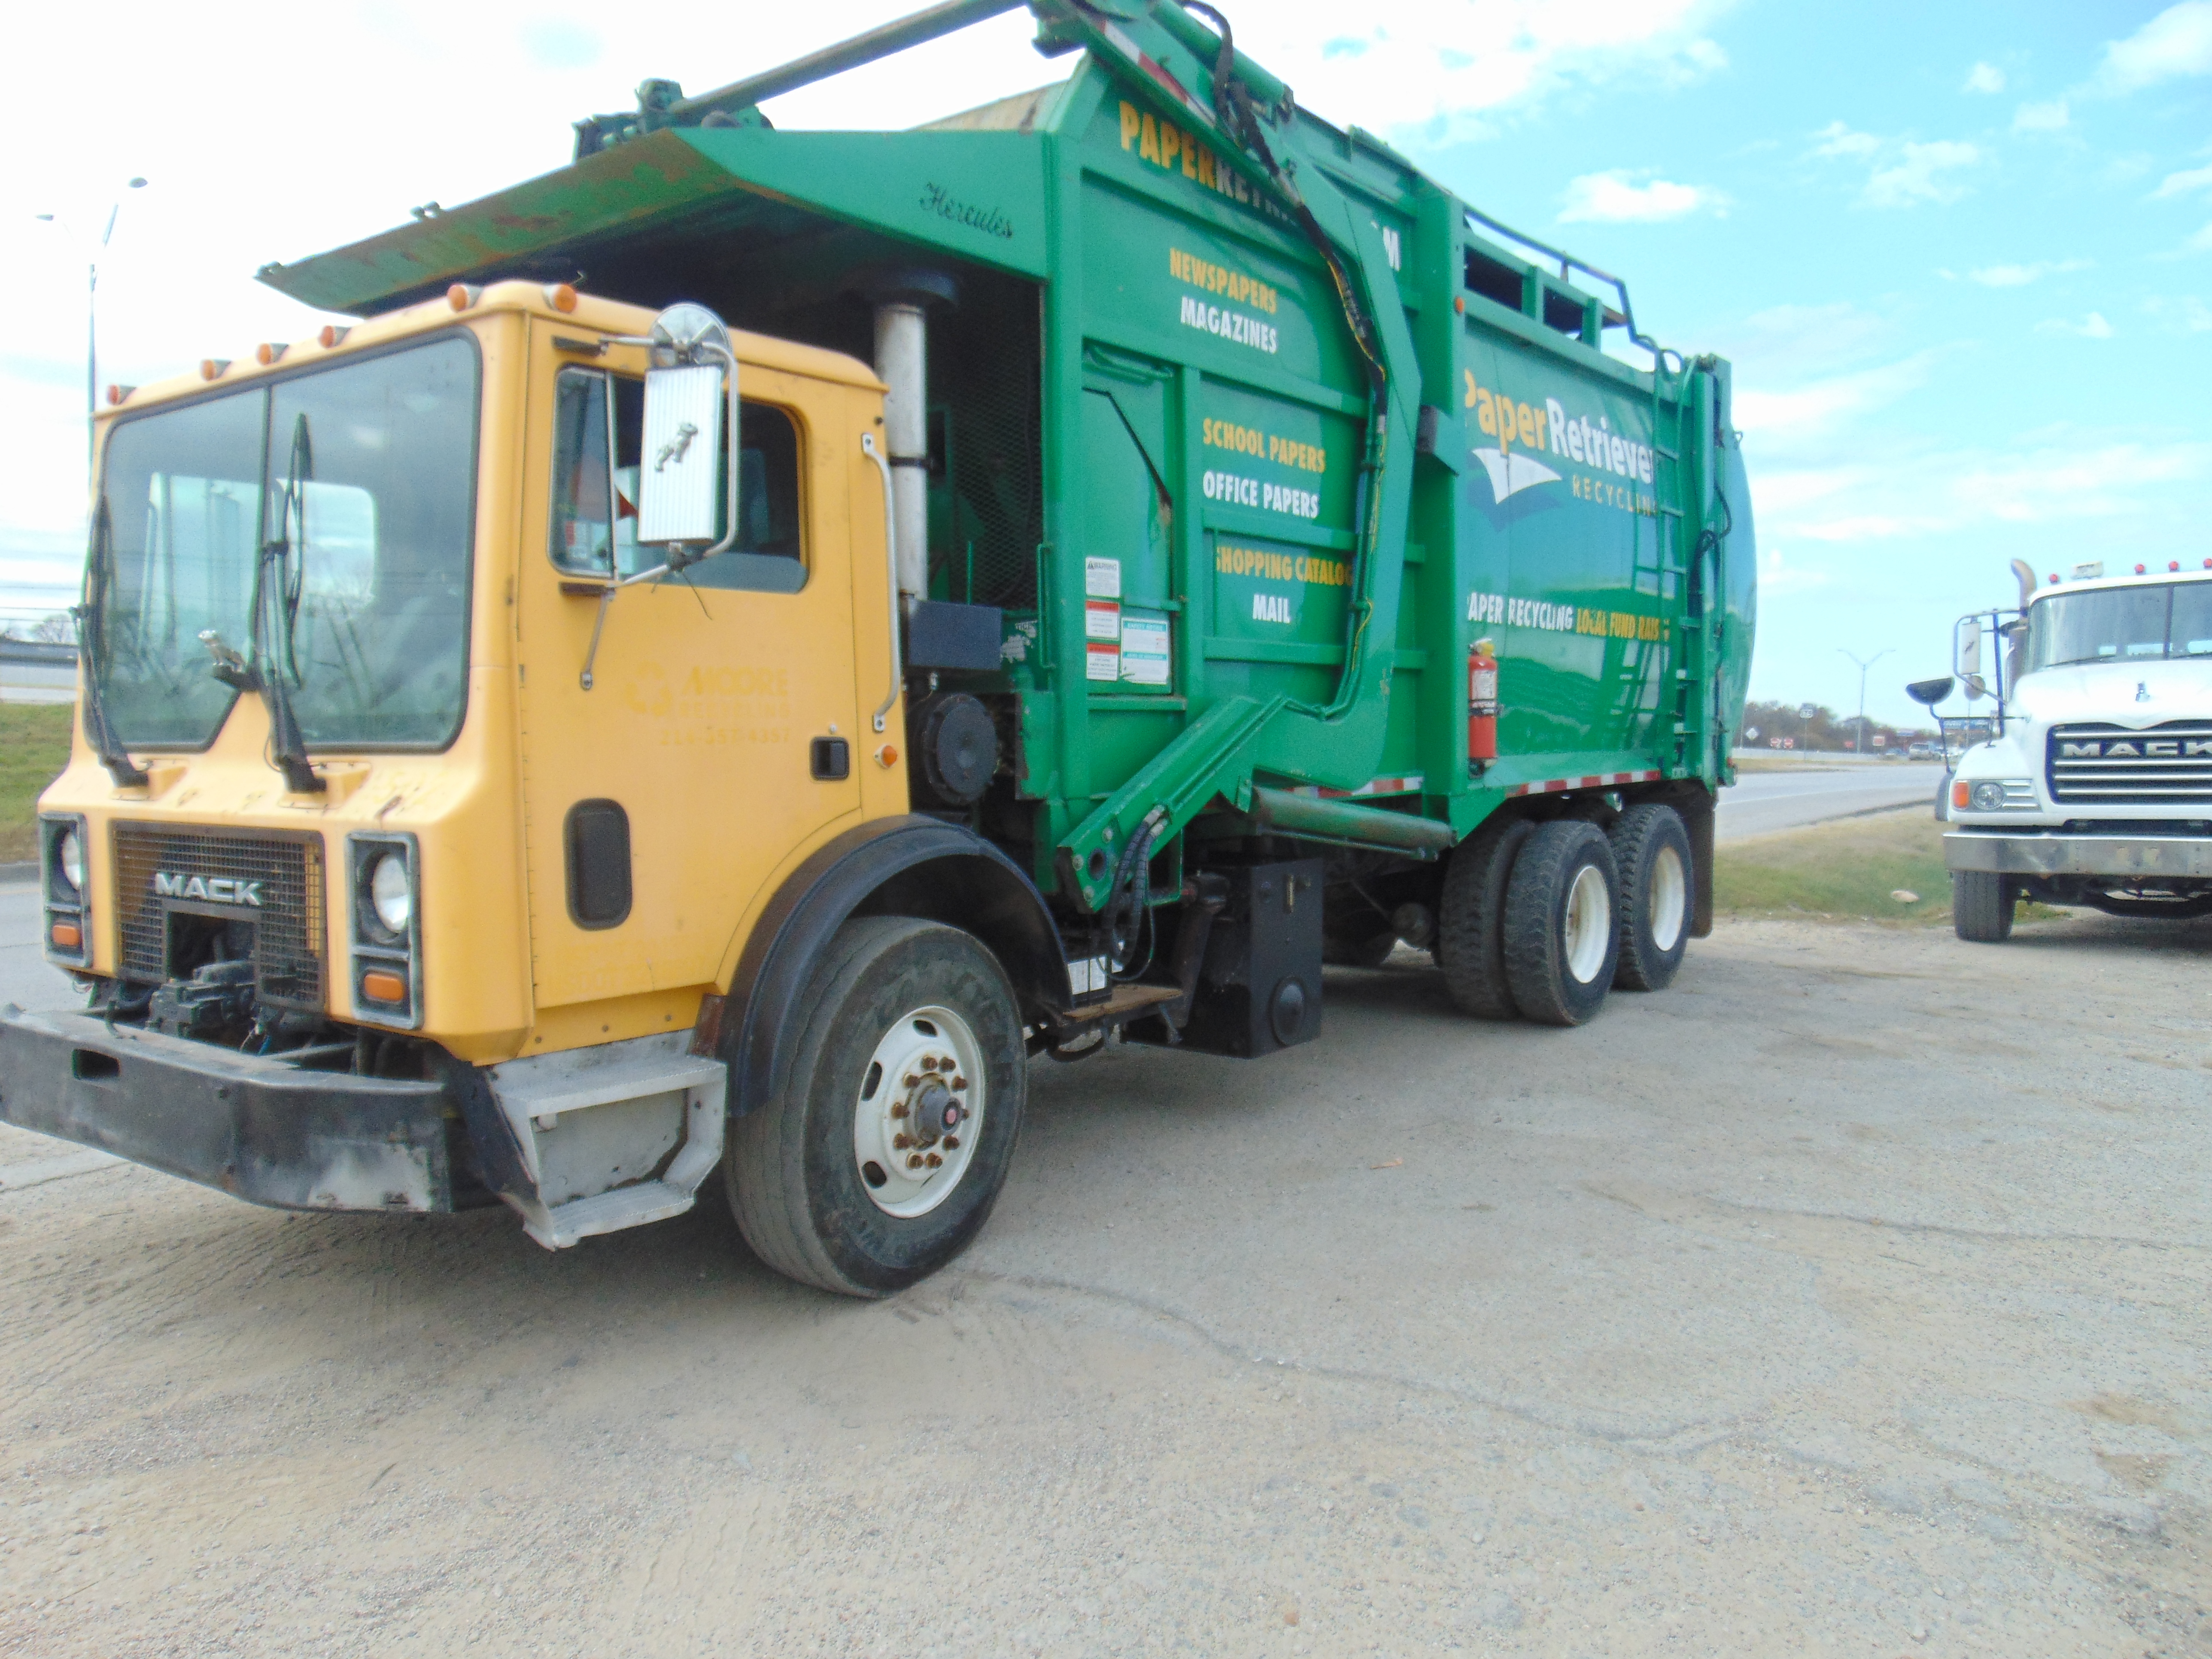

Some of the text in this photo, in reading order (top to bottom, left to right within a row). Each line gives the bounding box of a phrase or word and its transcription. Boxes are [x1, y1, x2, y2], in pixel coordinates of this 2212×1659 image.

[919, 182, 1014, 240] Hercules
[1169, 248, 1279, 315] NEWSPAPERS
[1181, 296, 1279, 355] MAGAZINES
[1203, 417, 1326, 473] SCHOOL PAPERS
[1203, 471, 1320, 519] OFFICE PAPERS
[1252, 593, 1291, 624] MAIL
[1467, 592, 1504, 624] APER
[1508, 598, 1574, 631] RECYCLING
[1610, 612, 1636, 639] FUND
[2062, 741, 2212, 757] MACK
[154, 872, 263, 906] MACK
